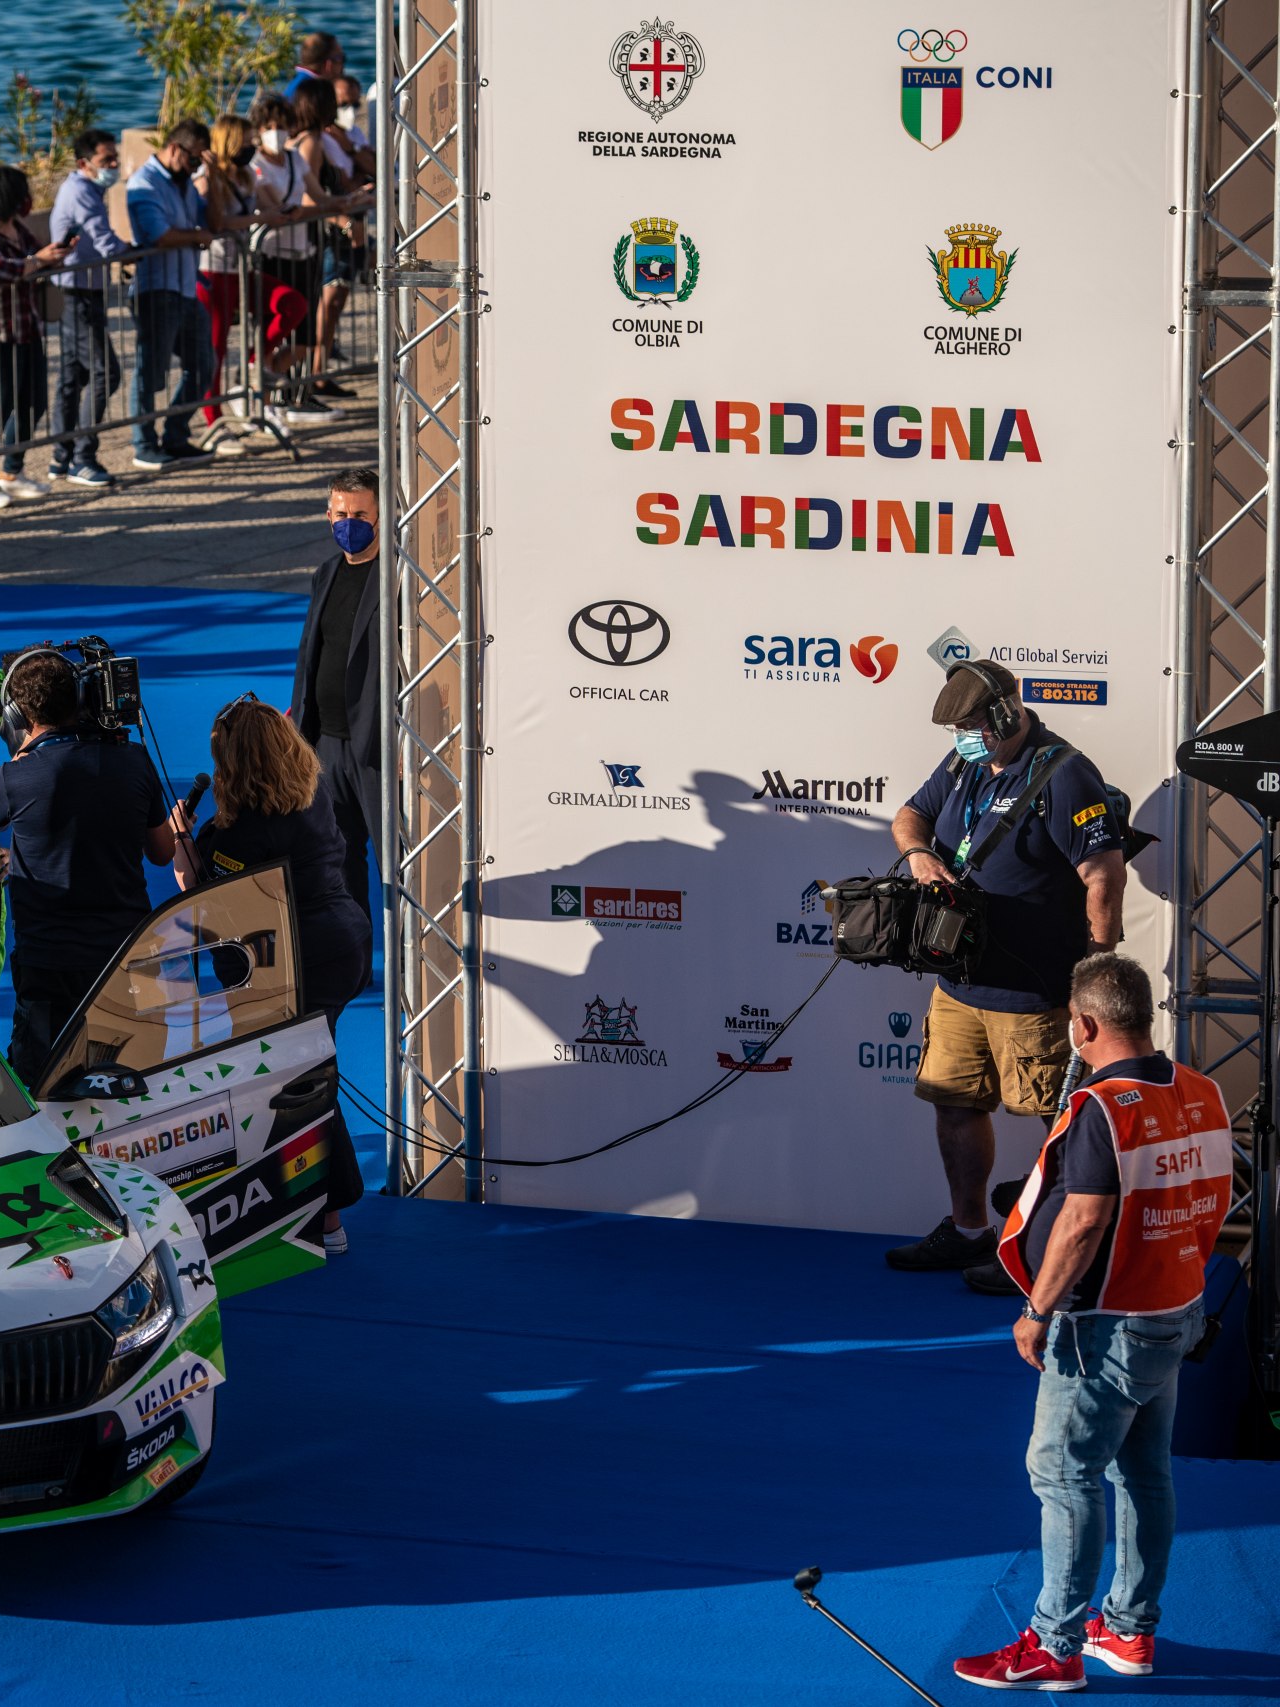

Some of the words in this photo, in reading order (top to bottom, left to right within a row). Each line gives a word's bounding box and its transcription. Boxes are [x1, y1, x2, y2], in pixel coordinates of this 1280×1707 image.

[906, 71, 959, 86] ITALIA
[975, 66, 1054, 90] CONI
[577, 131, 644, 146] REGIONE
[646, 131, 737, 146] AUTONOMA
[592, 145, 637, 158] DELLA
[640, 145, 723, 159] SARDEGNA
[612, 318, 685, 335] COMUNE
[687, 320, 704, 334] DI
[923, 325, 1000, 342] COMUNE
[1005, 328, 1023, 342] DI
[633, 333, 681, 348] OLBIA
[934, 341, 1012, 356] ALGHERO
[610, 397, 1043, 463] SARDEGNA
[742, 635, 842, 669] sara
[989, 647, 1012, 661] ACI
[1016, 646, 1058, 664] Global
[1062, 649, 1109, 665] Servizi
[743, 669, 757, 680] TI
[762, 669, 842, 683] ASSICURA
[1031, 681, 1065, 690] SOCCORSO
[569, 686, 636, 701] OFFICIAL
[639, 688, 669, 702] CAR
[1195, 741, 1216, 751] RDA
[1217, 743, 1233, 752] 800
[1234, 743, 1245, 752] W
[751, 769, 886, 805] Marriott
[547, 791, 638, 808] GRIMALDI
[641, 796, 691, 810] LINES
[774, 803, 871, 817] INTERNATIONAL
[593, 887, 680, 919] sardares
[585, 919, 624, 928] soluzioni
[626, 922, 642, 930] per
[776, 922, 834, 946] BAZ
[740, 1004, 770, 1018] San
[724, 1016, 785, 1031] Martino
[553, 1043, 668, 1067] SELLA&MOSCA
[858, 1042, 922, 1070] GIAR
[1117, 1091, 1141, 1105] 0024
[115, 1111, 230, 1163] SARDEGNA
[164, 1170, 192, 1186] ionship
[1143, 1207, 1173, 1227] RALLY
[126, 1425, 176, 1472] ŠKODA
